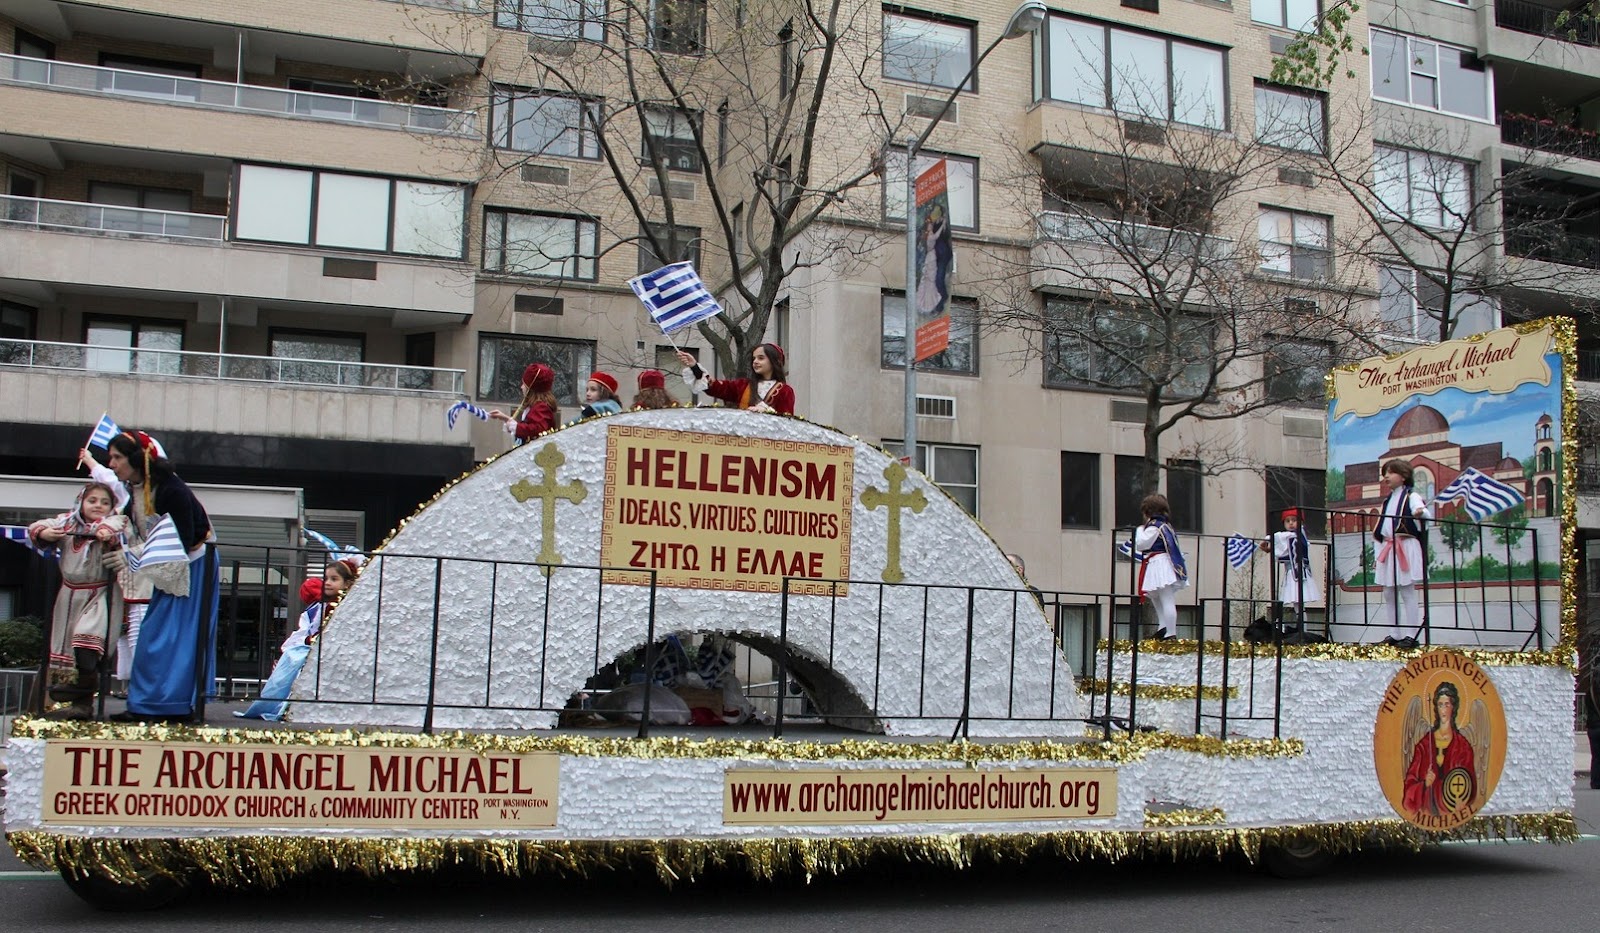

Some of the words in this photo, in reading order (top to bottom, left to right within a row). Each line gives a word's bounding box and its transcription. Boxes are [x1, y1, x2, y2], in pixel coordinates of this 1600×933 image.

[1358, 367, 1388, 389] The
[1387, 349, 1454, 384] Archangel
[1455, 337, 1521, 370] Michael
[1382, 384, 1402, 396] PORT
[627, 447, 837, 502] HELLENISM
[763, 508, 839, 539] CULTURES
[1382, 680, 1403, 715] THE
[1404, 653, 1491, 696] ARCHANGEL
[64, 747, 142, 787] THE
[153, 750, 356, 792] ARCHANGEL
[368, 755, 533, 795] MICHAEL
[54, 791, 120, 815] GREEK
[124, 793, 230, 818] ORTHODOX
[234, 795, 306, 818] CHURCH
[309, 803, 318, 818] &
[321, 796, 418, 819] COMMUNITY
[422, 798, 479, 820] CENTER
[483, 799, 500, 808] PORT
[502, 799, 549, 809] WASHINGTON
[500, 809, 520, 820] N.Y.
[1413, 804, 1478, 828] MICHAEL
